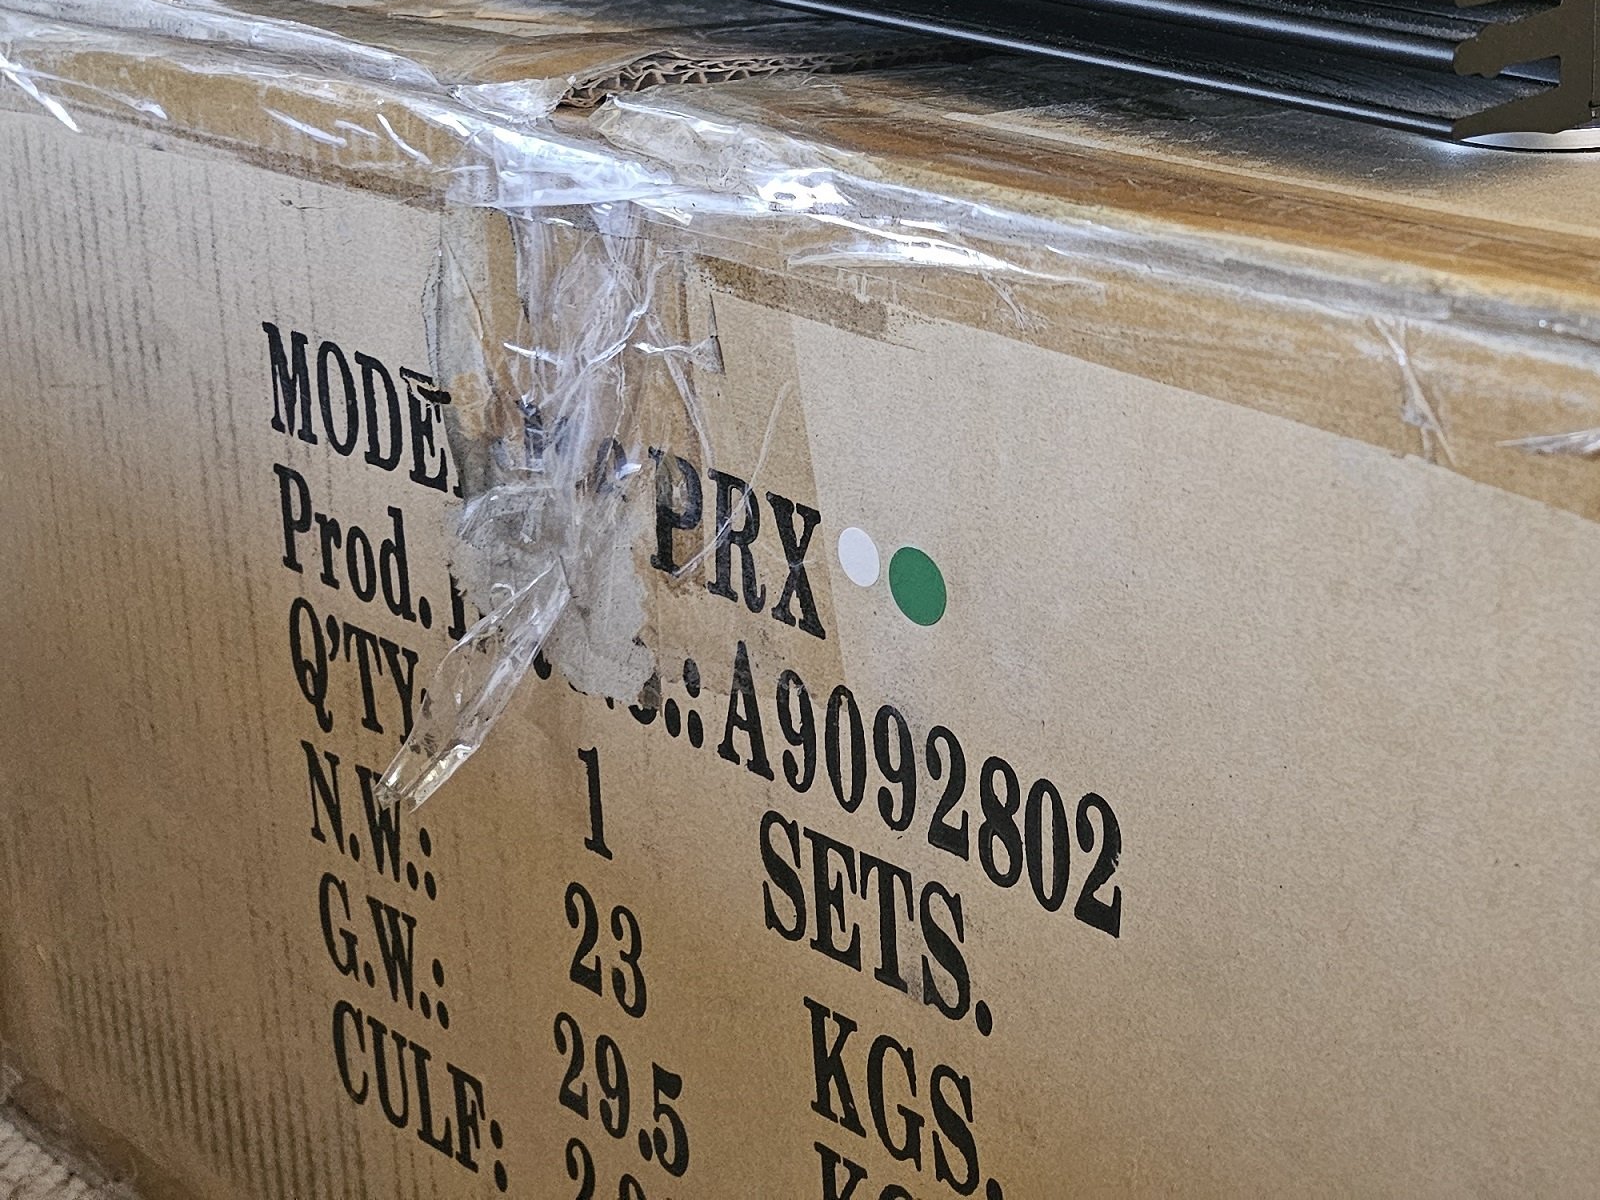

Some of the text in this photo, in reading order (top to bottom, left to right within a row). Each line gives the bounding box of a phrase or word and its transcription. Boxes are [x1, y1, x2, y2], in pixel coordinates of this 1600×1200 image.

[262, 321, 464, 499] MODE
[274, 463, 432, 629] Prod.
[300, 740, 436, 901] N.W.:
[565, 882, 646, 1018] 23
[577, 747, 612, 860] 1
[760, 810, 993, 1037] SETS.
[319, 872, 689, 1177] G.W.: 29.5
[333, 1000, 508, 1192] CULF:
